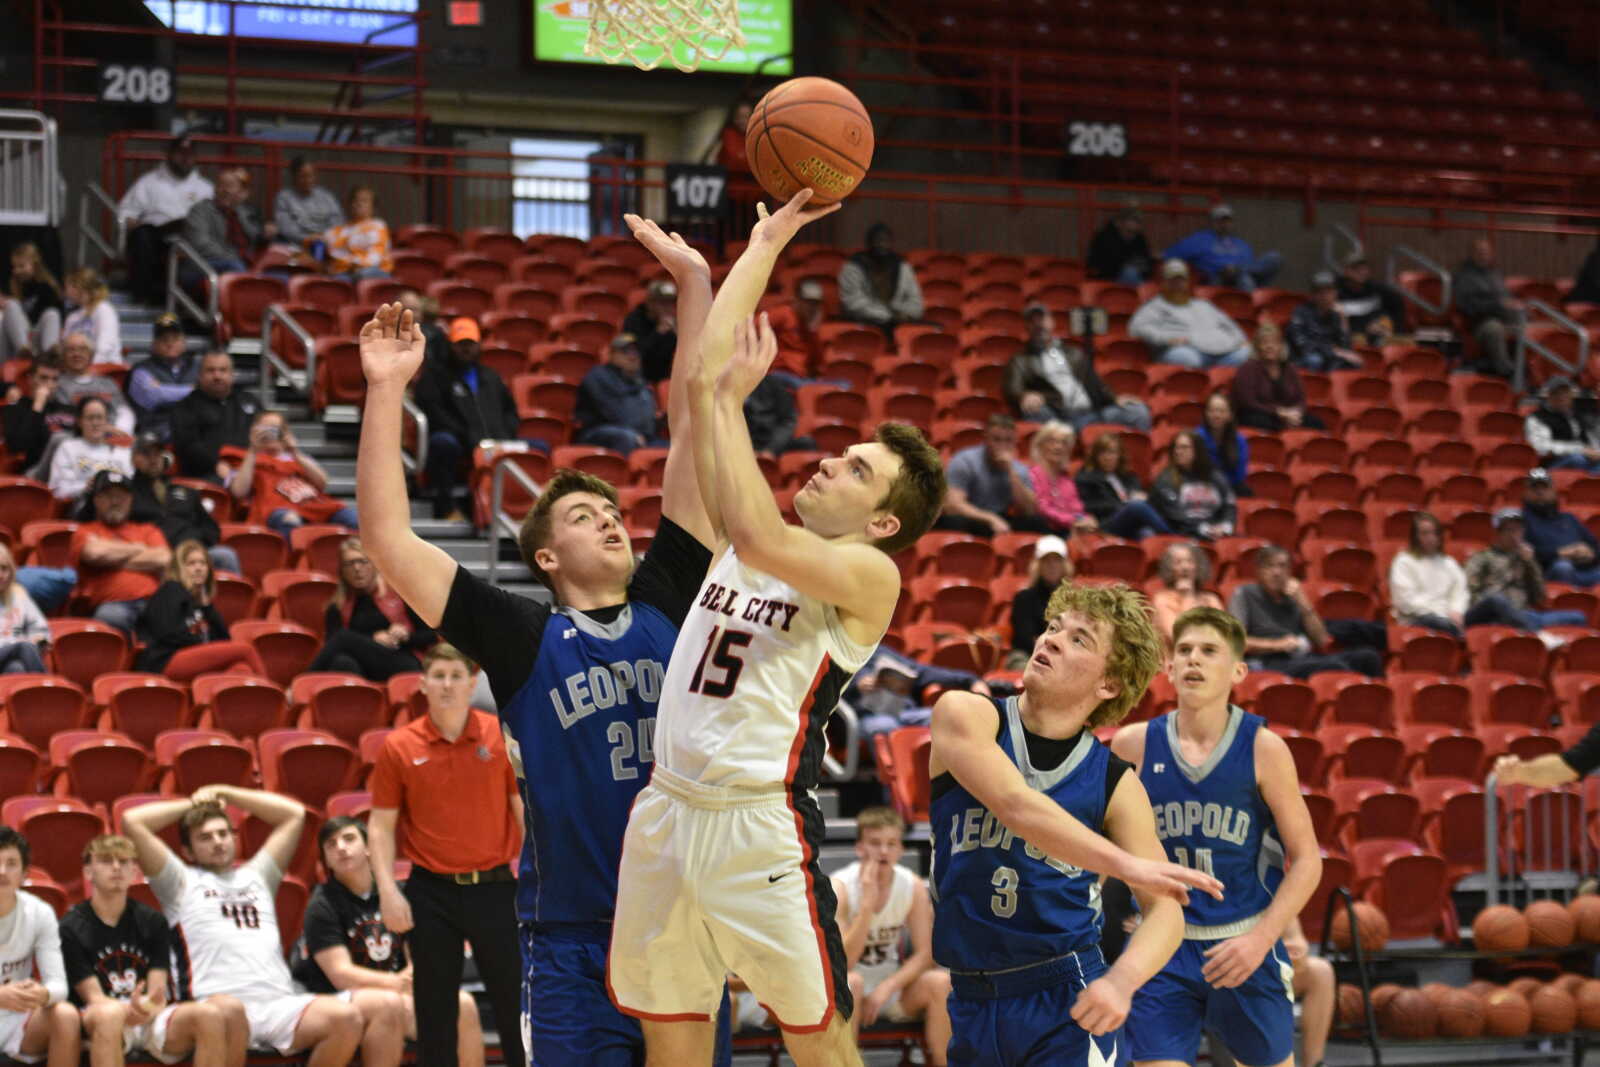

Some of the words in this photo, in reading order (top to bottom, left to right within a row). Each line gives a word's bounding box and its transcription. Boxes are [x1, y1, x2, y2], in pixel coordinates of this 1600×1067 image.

[103, 65, 170, 103] 208
[1069, 122, 1126, 157] 206
[671, 174, 724, 208] 107
[700, 583, 739, 616] BEL
[741, 597, 800, 632] CITY
[688, 625, 753, 699] 15
[1152, 800, 1250, 846] EOPOLD
[990, 865, 1019, 919] 3
[221, 902, 260, 930] 40
